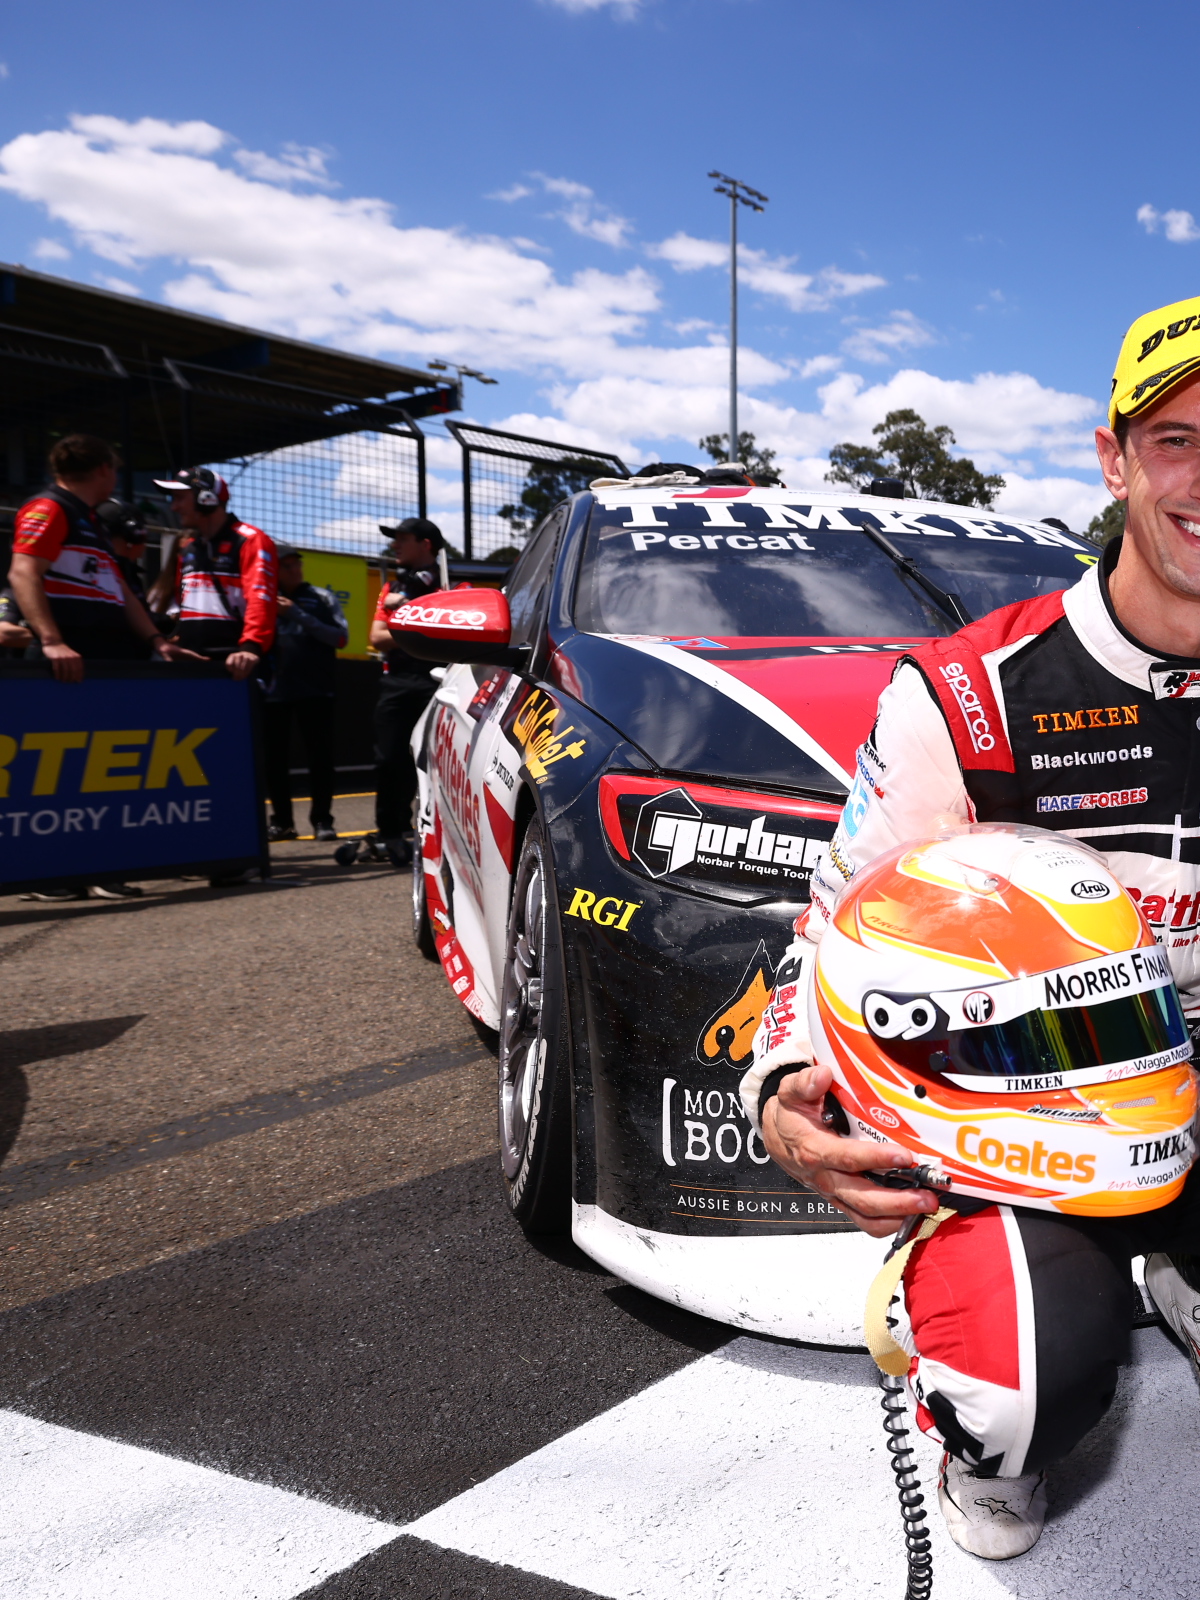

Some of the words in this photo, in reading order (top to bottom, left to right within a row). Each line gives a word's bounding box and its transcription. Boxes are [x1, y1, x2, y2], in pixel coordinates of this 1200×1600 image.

[605, 502, 1089, 551] TIMKEN
[631, 531, 816, 553] Percat
[392, 604, 487, 628] sparco
[940, 662, 995, 753] sparco
[1032, 705, 1139, 734] TIMKEN
[1031, 744, 1153, 770] Blackwoods
[1037, 787, 1148, 812] HARE&FORBES
[121, 799, 212, 828] LANE
[696, 854, 735, 870] Norbar
[737, 860, 779, 877] Torque
[782, 868, 814, 881] Tools
[1075, 882, 1106, 896] Arai
[564, 887, 641, 932] RGI
[1044, 963, 1131, 1008] MORRIS
[1133, 1054, 1172, 1071] Wagga
[1005, 1074, 1063, 1091] TIMKEN
[858, 1121, 882, 1143] Guide
[1128, 1121, 1195, 1166] TIMKEN
[955, 1125, 1097, 1184] Coates
[1137, 1171, 1173, 1186] Wagga
[677, 1194, 730, 1212] AUSSIE
[737, 1199, 782, 1214] BORN
[789, 1201, 800, 1214] &
